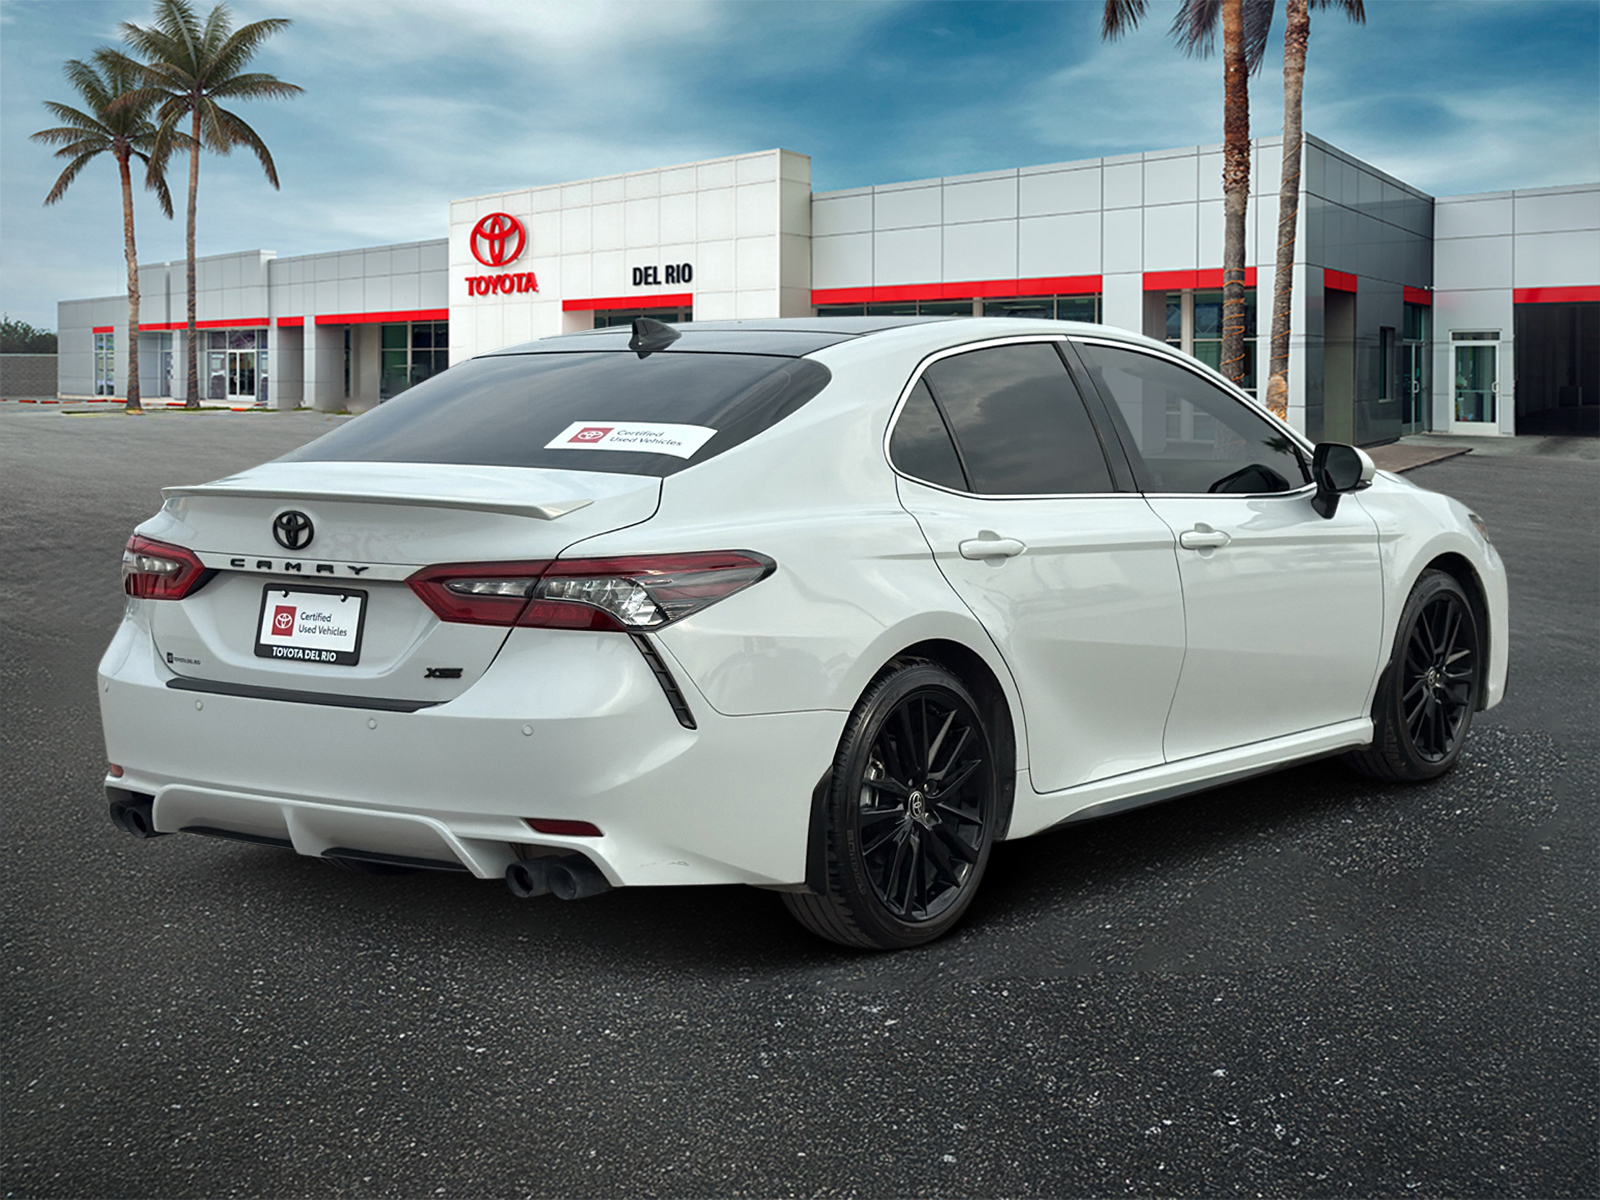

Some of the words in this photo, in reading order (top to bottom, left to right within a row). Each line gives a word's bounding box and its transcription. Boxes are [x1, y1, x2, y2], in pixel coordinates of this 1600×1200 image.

[633, 266, 661, 286] DEL
[666, 263, 693, 283] RIO
[465, 272, 538, 296] TOYOTA
[640, 438, 682, 446] Vehicles
[230, 558, 369, 575] CAMRY
[300, 612, 332, 622] Certified
[298, 624, 317, 634] Used
[318, 627, 347, 637] Vehicles
[272, 647, 303, 659] TOYOTA
[304, 649, 320, 660] DEL
[321, 652, 337, 662] RIO
